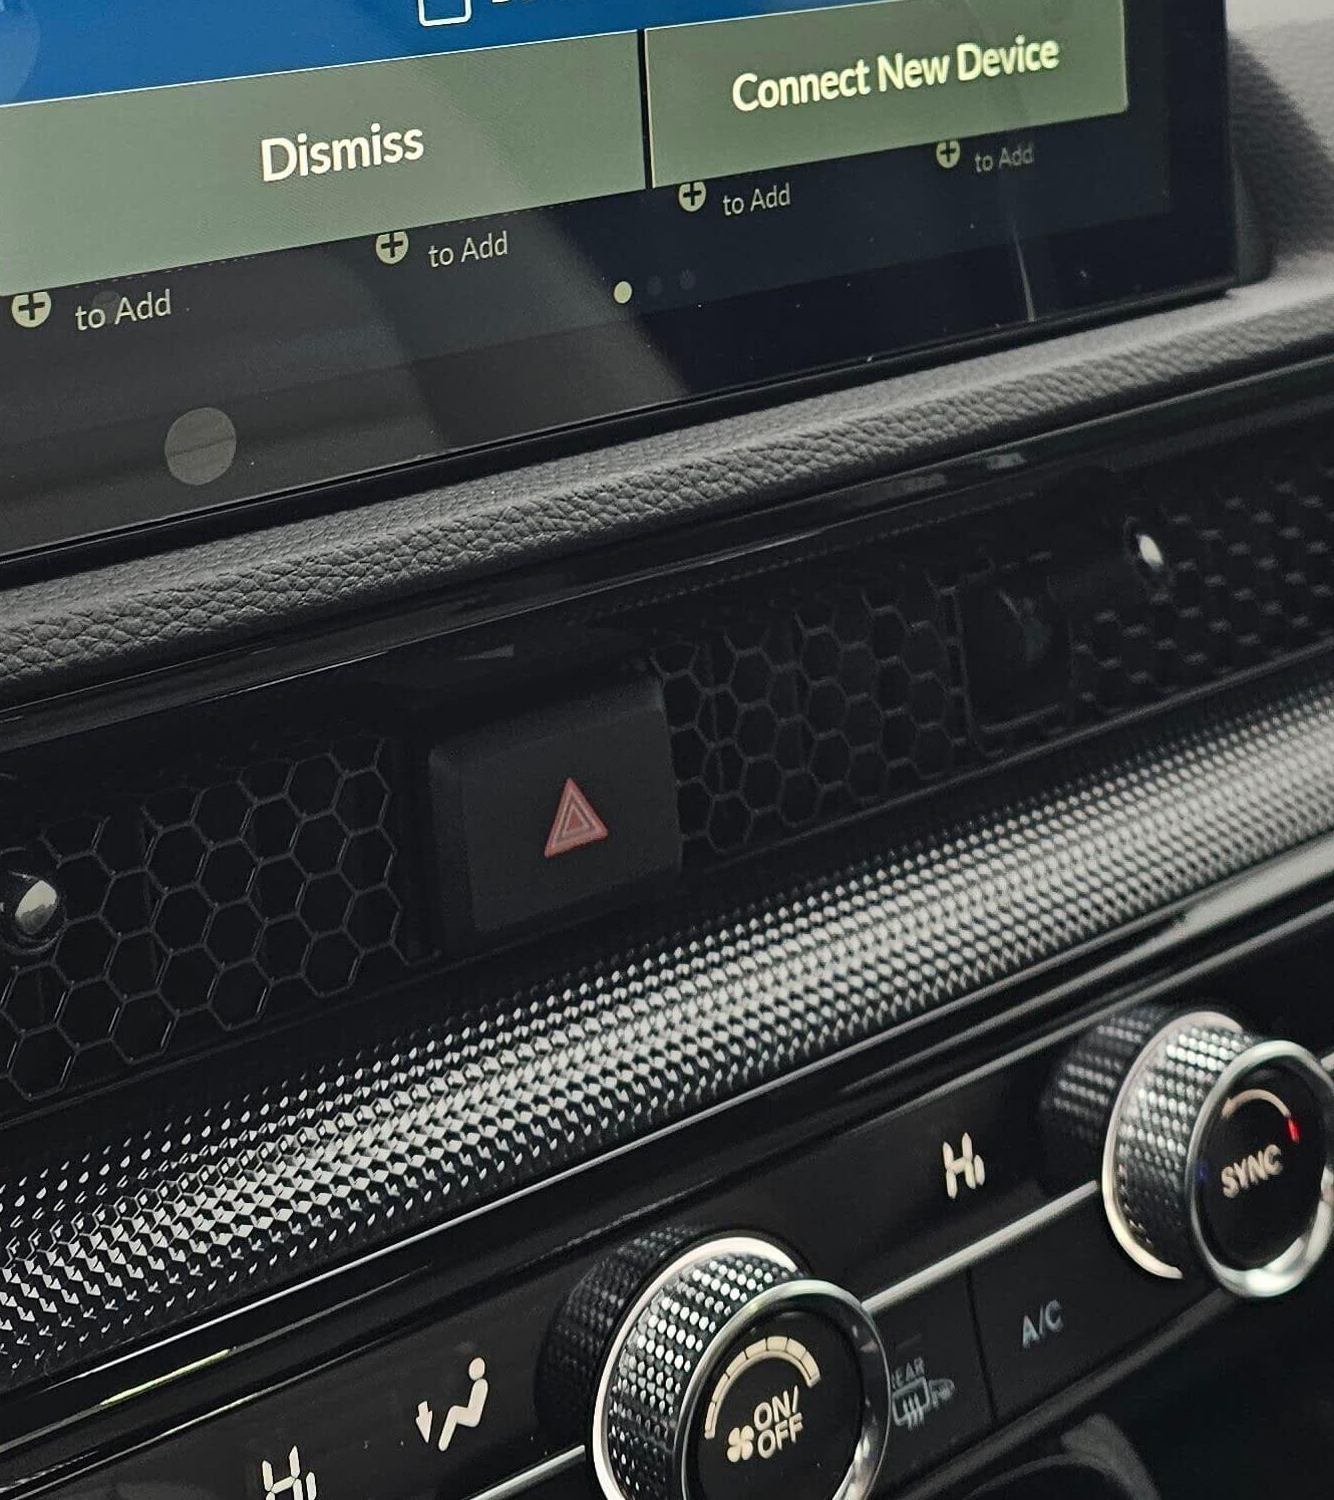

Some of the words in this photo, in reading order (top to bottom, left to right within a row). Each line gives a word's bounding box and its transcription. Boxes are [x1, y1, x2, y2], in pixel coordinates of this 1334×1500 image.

[731, 58, 870, 112] Connect
[877, 48, 951, 91] New
[956, 33, 1060, 82] Device
[261, 122, 425, 182] Dismiss
[974, 153, 995, 174] to
[999, 143, 1035, 169] Add
[722, 192, 745, 217] to
[750, 183, 791, 213] Add
[428, 244, 455, 269] to
[461, 230, 509, 265] Add
[75, 305, 106, 331] to
[114, 289, 172, 326] Add
[1221, 1143, 1284, 1198] SYNC
[1021, 1299, 1063, 1349] A/C
[753, 1385, 799, 1432] ON/
[757, 1412, 803, 1459] OFF
